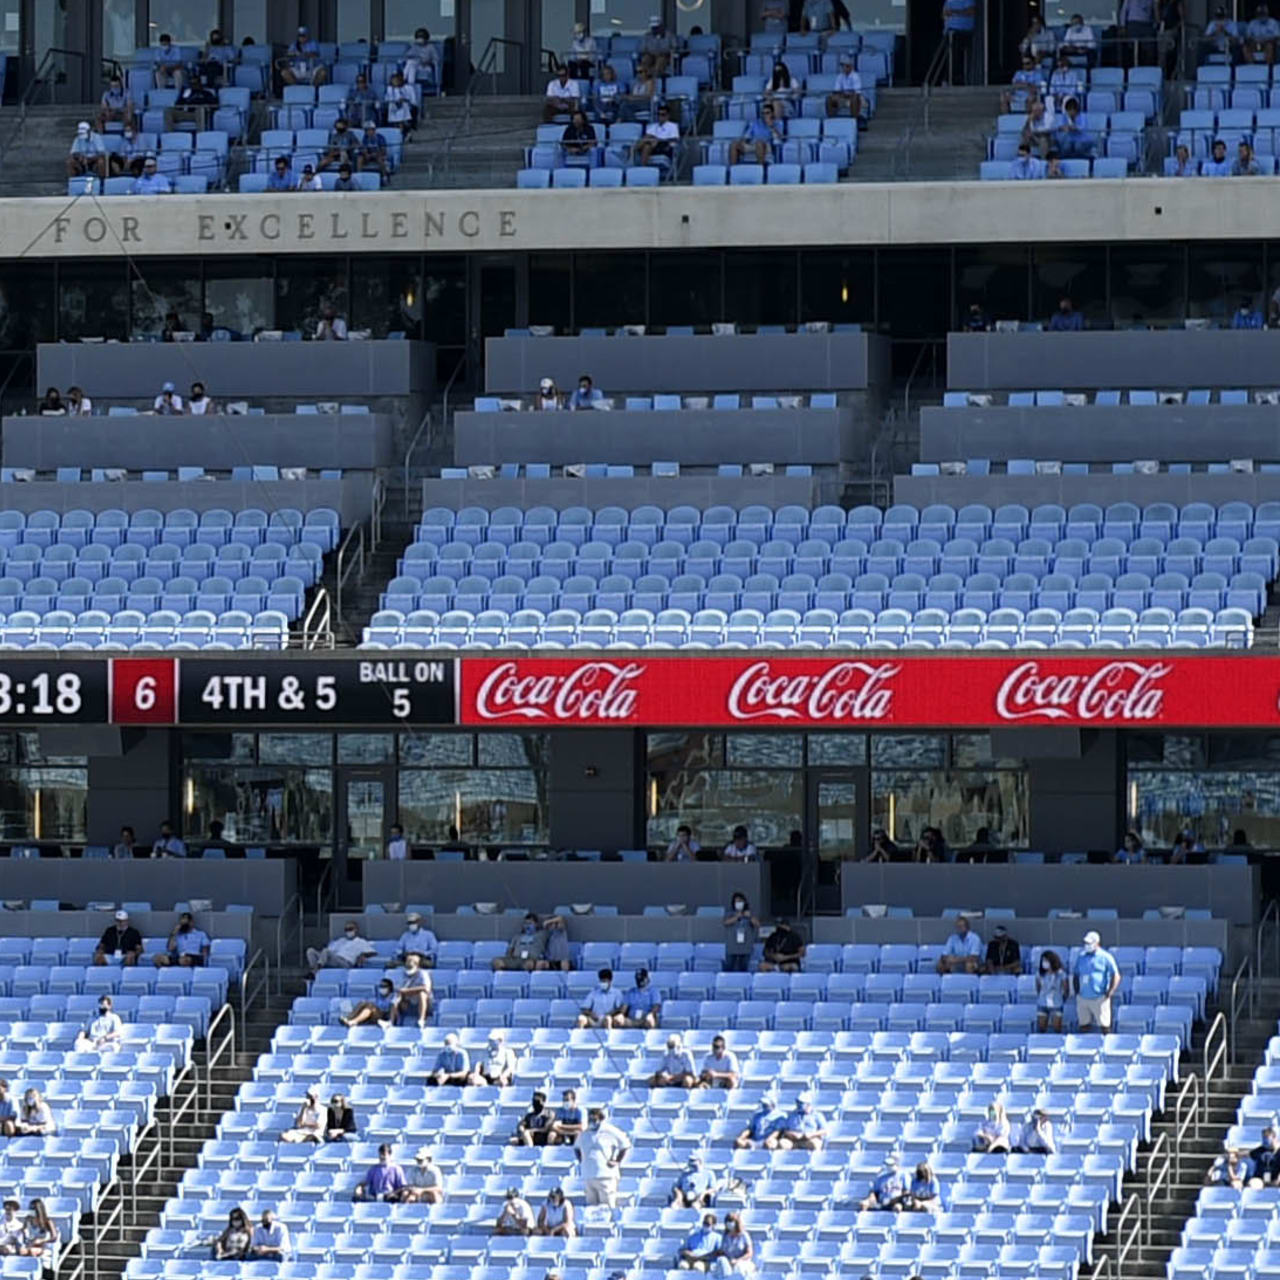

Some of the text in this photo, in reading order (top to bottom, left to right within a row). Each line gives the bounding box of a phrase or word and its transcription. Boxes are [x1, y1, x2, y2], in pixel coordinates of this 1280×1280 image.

[54, 215, 143, 245] FOR
[197, 209, 521, 242] EXCELLENCE
[359, 660, 444, 683] BALL ON
[133, 675, 156, 711] 6
[201, 675, 337, 711] 4TH & 5
[391, 688, 411, 717] 5
[476, 661, 648, 720] Coca-Cola
[727, 661, 904, 720] Coca-Cola
[995, 661, 1175, 720] Coca-Cola
